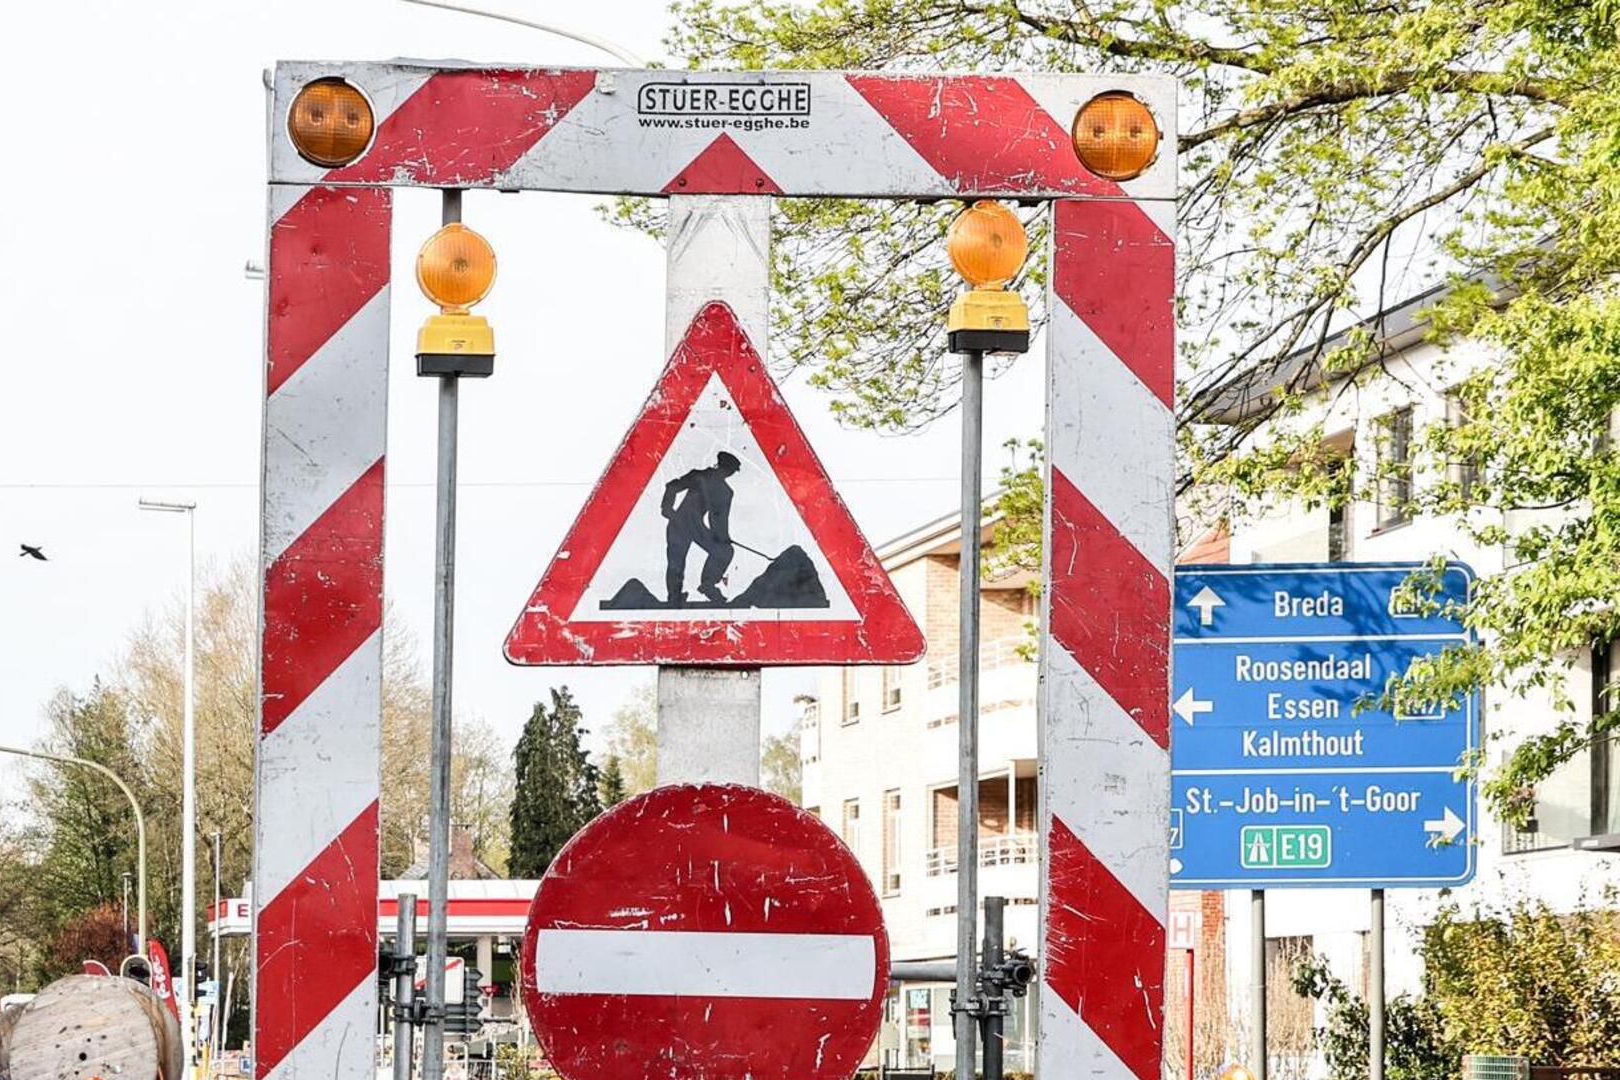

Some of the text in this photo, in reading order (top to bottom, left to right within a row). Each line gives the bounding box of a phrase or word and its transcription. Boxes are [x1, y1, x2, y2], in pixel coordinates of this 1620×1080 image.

[645, 88, 807, 111] STUER-EGGHE
[638, 117, 811, 131] www.stuer-egghe.be
[1274, 590, 1344, 618] Breda
[1235, 653, 1372, 682] Roosendaal
[1267, 692, 1340, 720] Essen
[1242, 729, 1364, 758] Kalmthout
[1281, 833, 1323, 860] E19
[1173, 915, 1191, 942] H
